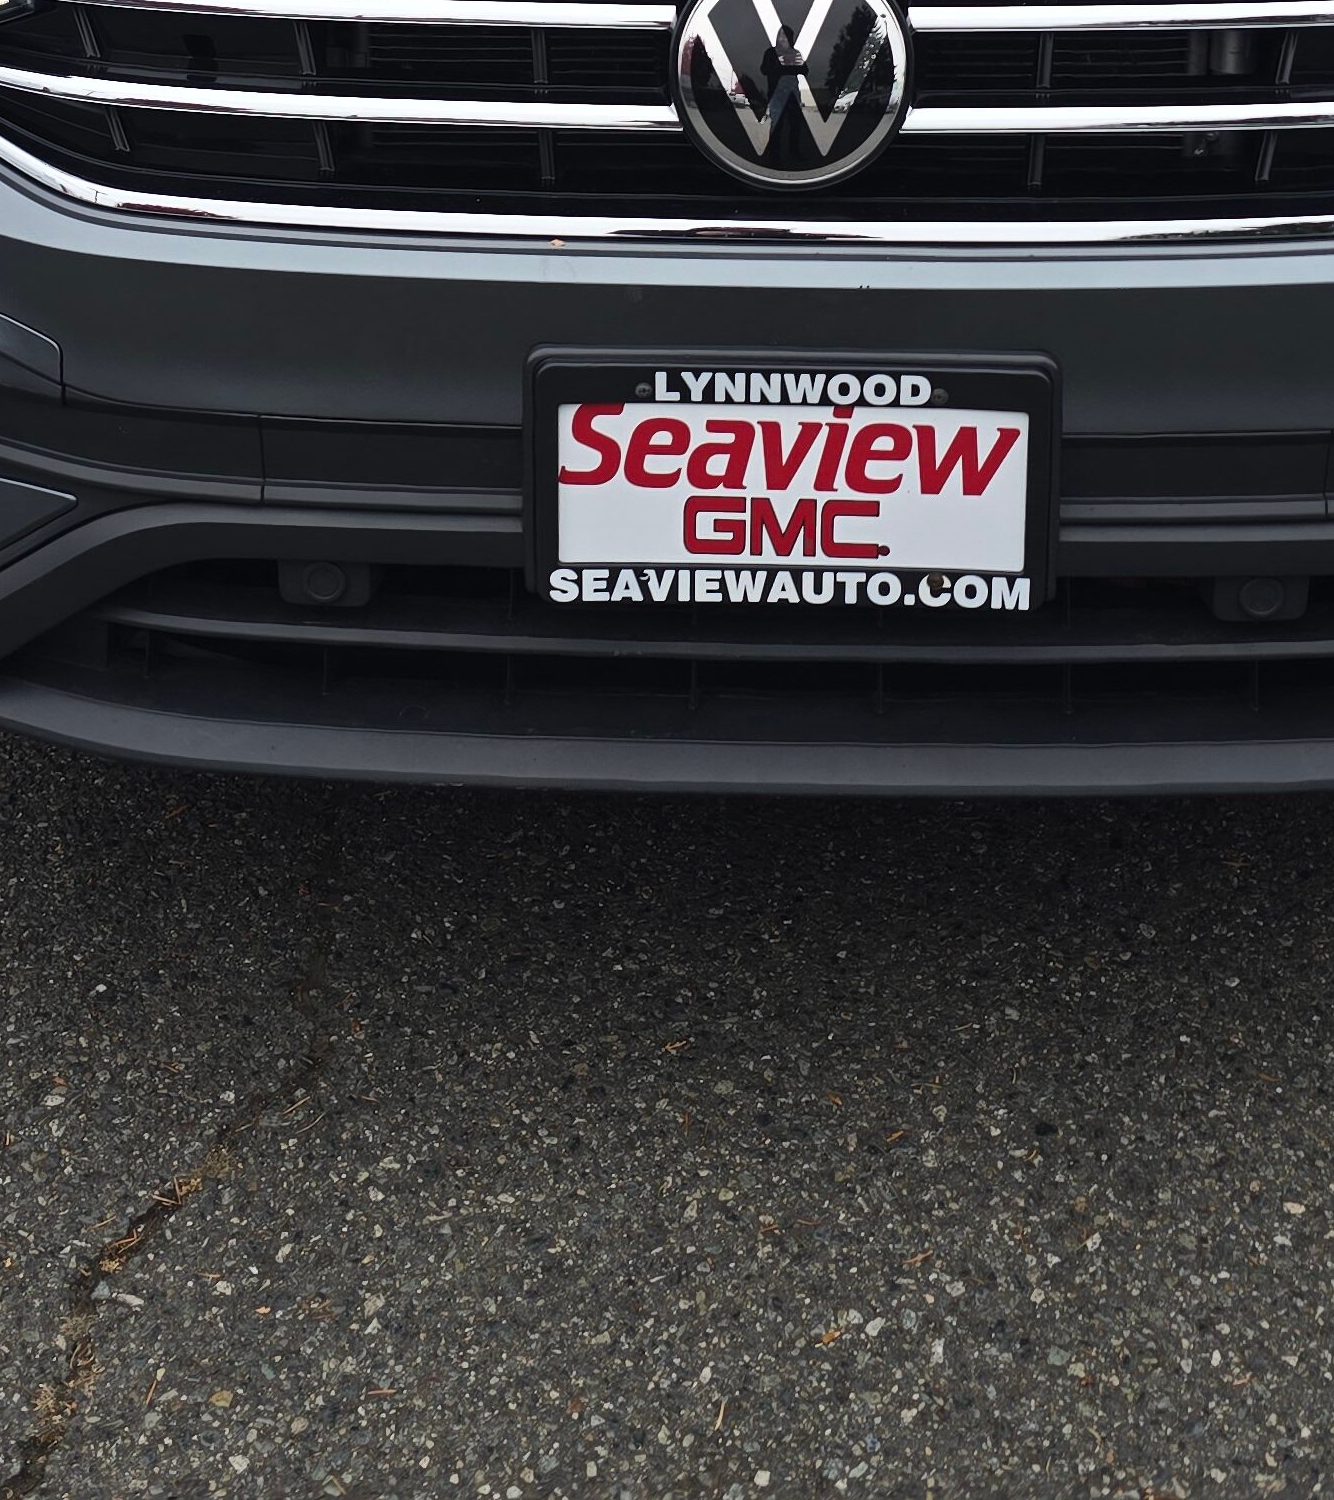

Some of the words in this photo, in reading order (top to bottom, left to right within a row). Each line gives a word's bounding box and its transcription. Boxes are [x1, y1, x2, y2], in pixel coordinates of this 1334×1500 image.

[655, 371, 932, 406] LYNNWOOD
[557, 403, 1021, 496] Seaview
[683, 495, 886, 559] GMC
[549, 568, 1031, 611] SEAVIEWAUTO.COM
